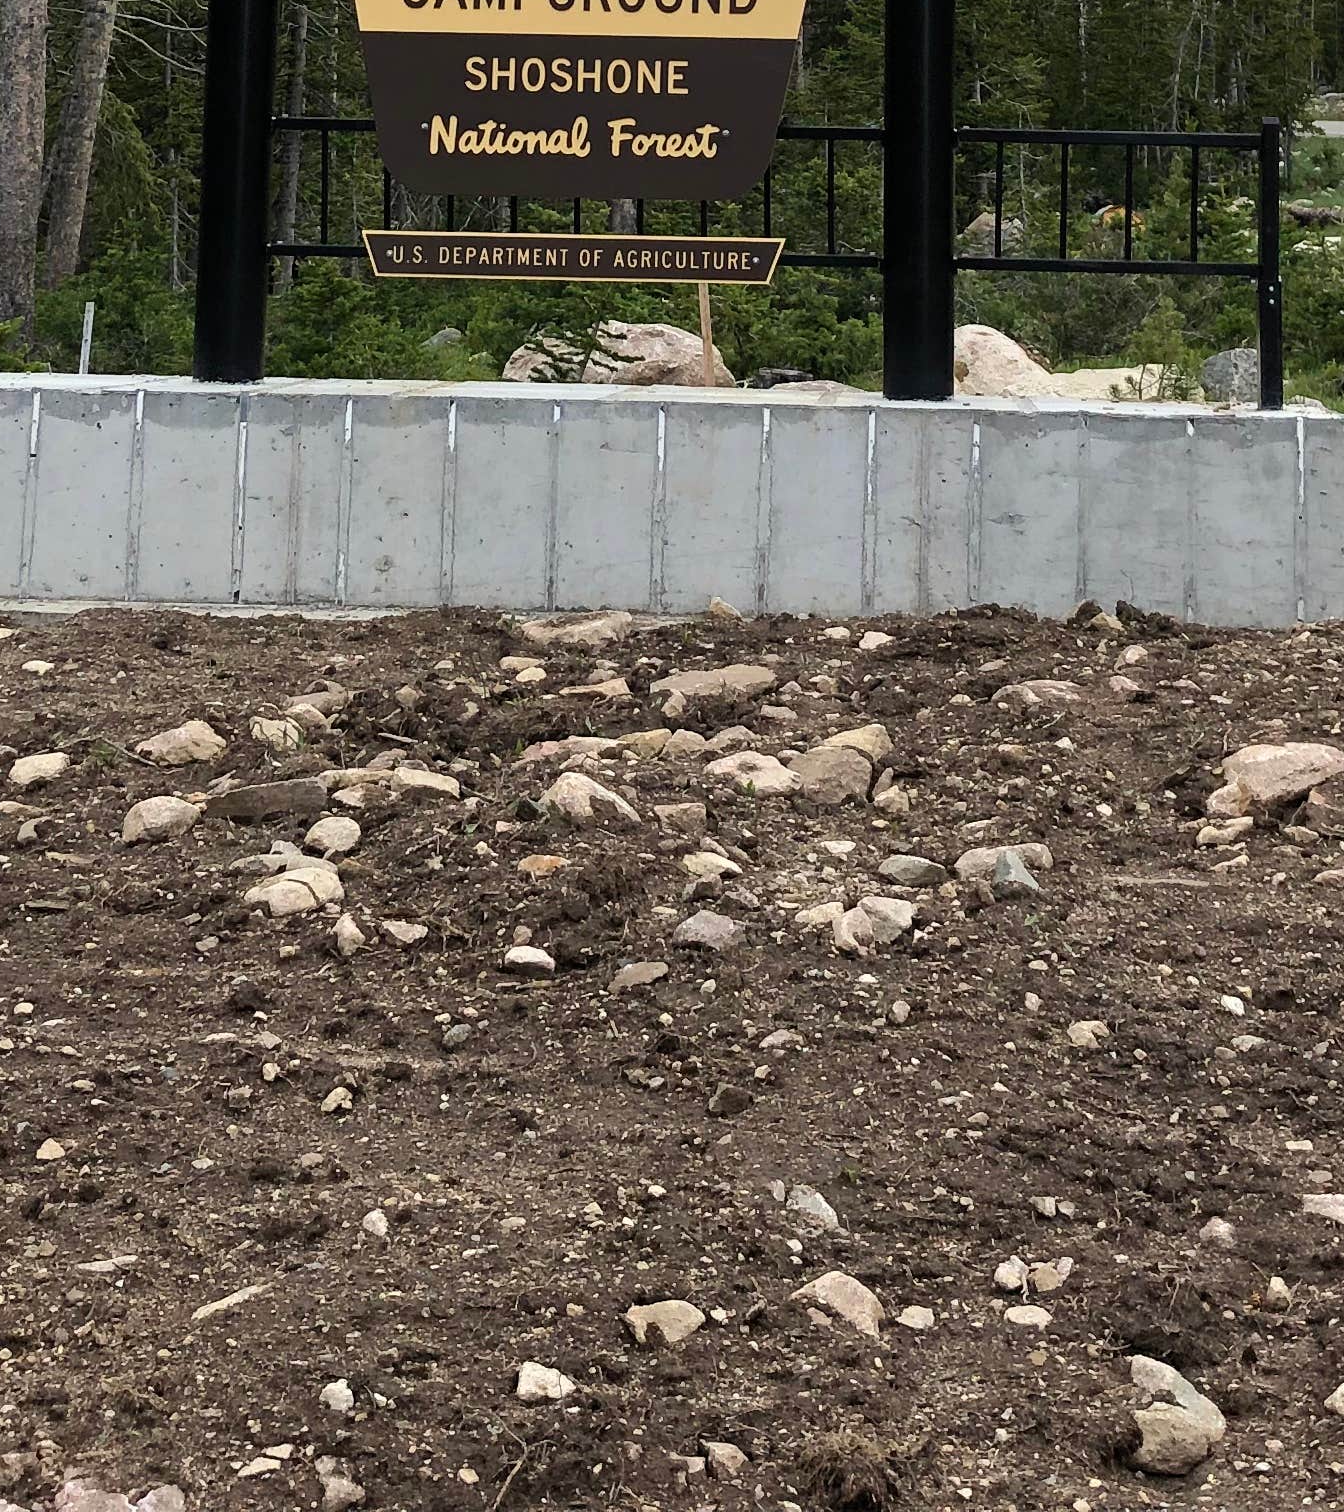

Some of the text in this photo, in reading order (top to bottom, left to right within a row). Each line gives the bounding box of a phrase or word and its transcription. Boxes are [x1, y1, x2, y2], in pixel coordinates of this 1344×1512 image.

[464, 55, 689, 95] SHOSHONE
[428, 114, 720, 159] National Forest
[392, 245, 752, 271] U.S. DEPARTMENT OF AGRICULTURE
